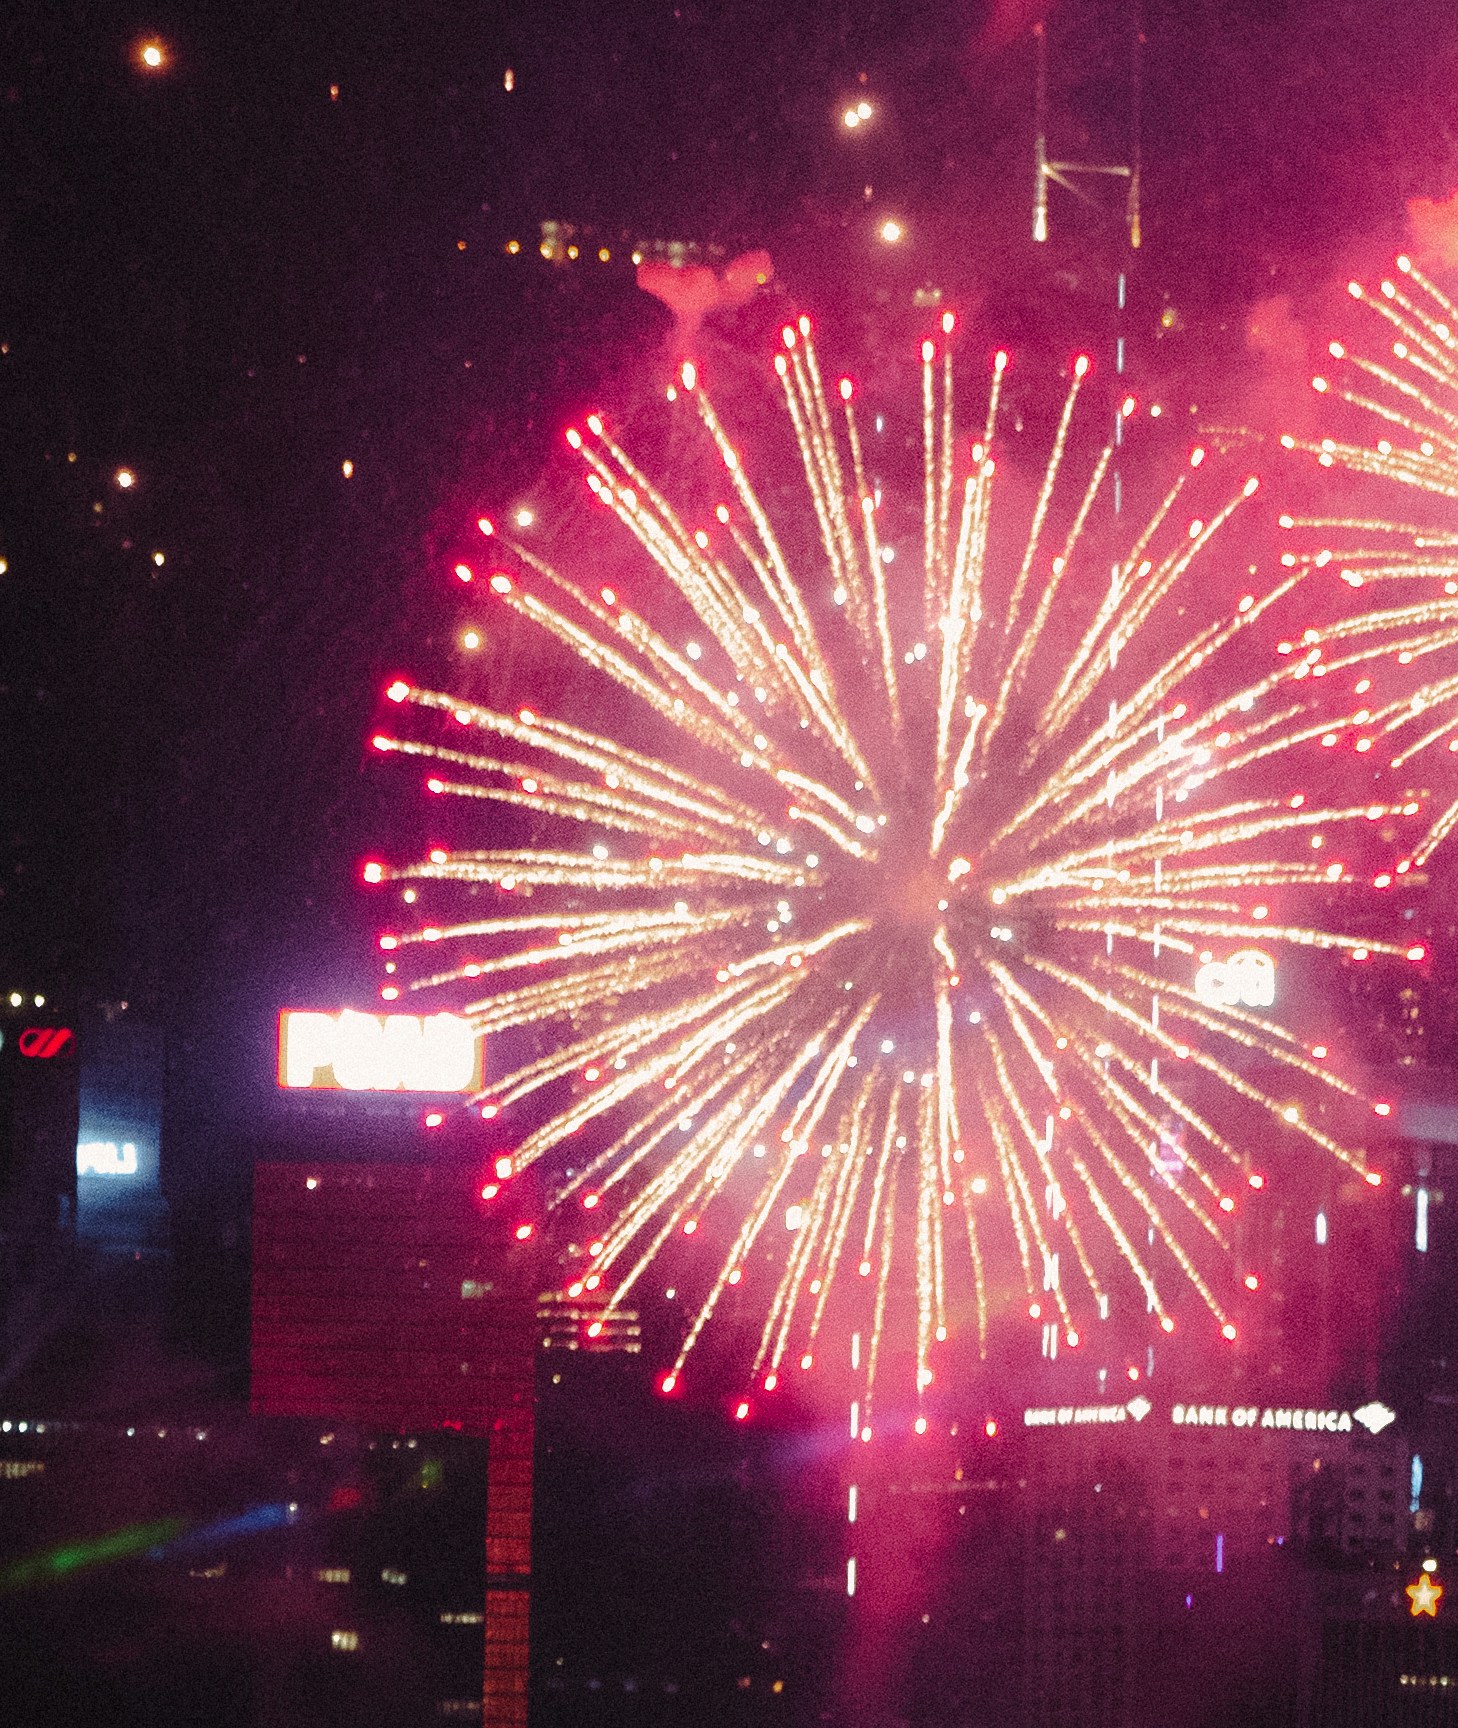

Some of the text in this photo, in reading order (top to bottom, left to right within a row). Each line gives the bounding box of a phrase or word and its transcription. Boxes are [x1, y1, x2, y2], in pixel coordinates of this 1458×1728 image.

[1172, 1405, 1352, 1432] BANK OF AMERICA
